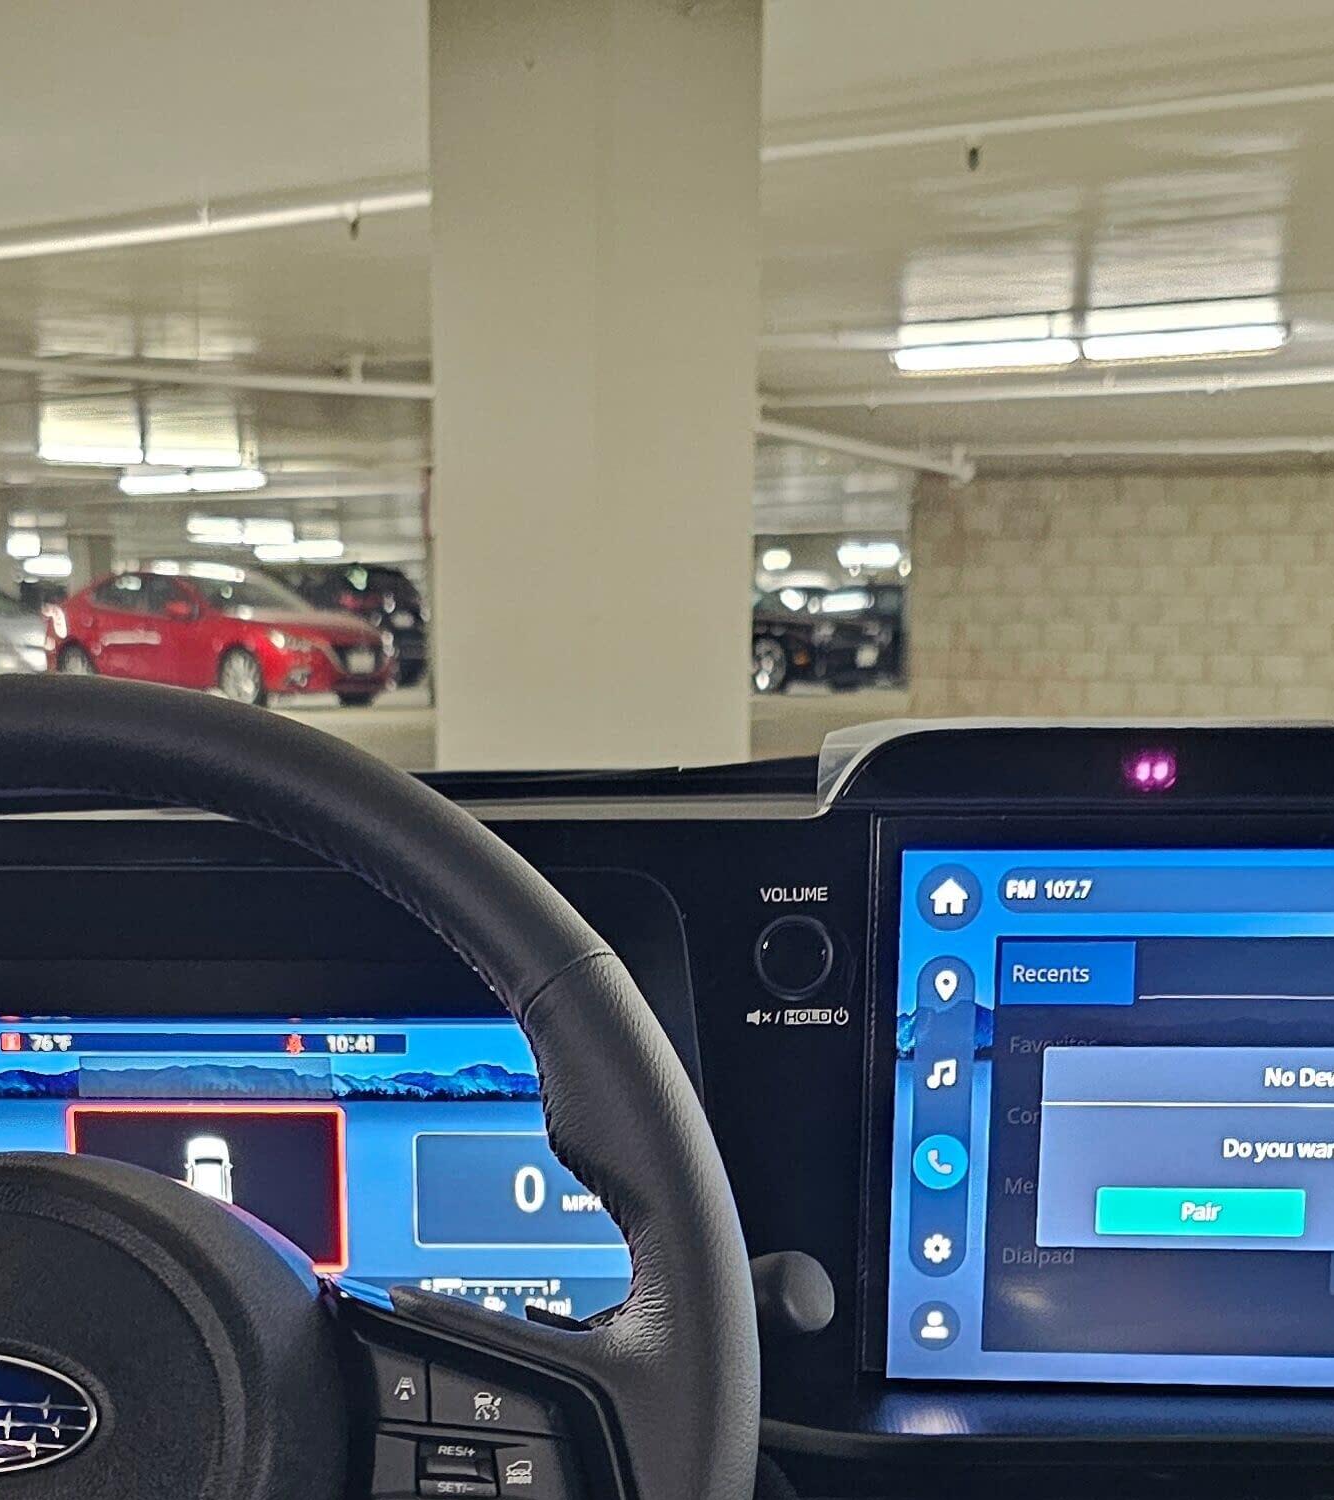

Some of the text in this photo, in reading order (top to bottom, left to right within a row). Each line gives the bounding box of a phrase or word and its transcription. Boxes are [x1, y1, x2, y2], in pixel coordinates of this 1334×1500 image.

[759, 886, 829, 902] VOLUME
[1005, 879, 1093, 900] FM 107.7
[1012, 964, 1090, 984] Recents
[785, 1009, 832, 1025] HOLD
[326, 1034, 376, 1053] 10:41
[1264, 1067, 1296, 1087] No
[1222, 1137, 1252, 1159] Do
[1253, 1142, 1294, 1164] you
[514, 1165, 546, 1214] 0
[1179, 1200, 1223, 1222] Pair
[1002, 1246, 1075, 1267] Dialpad
